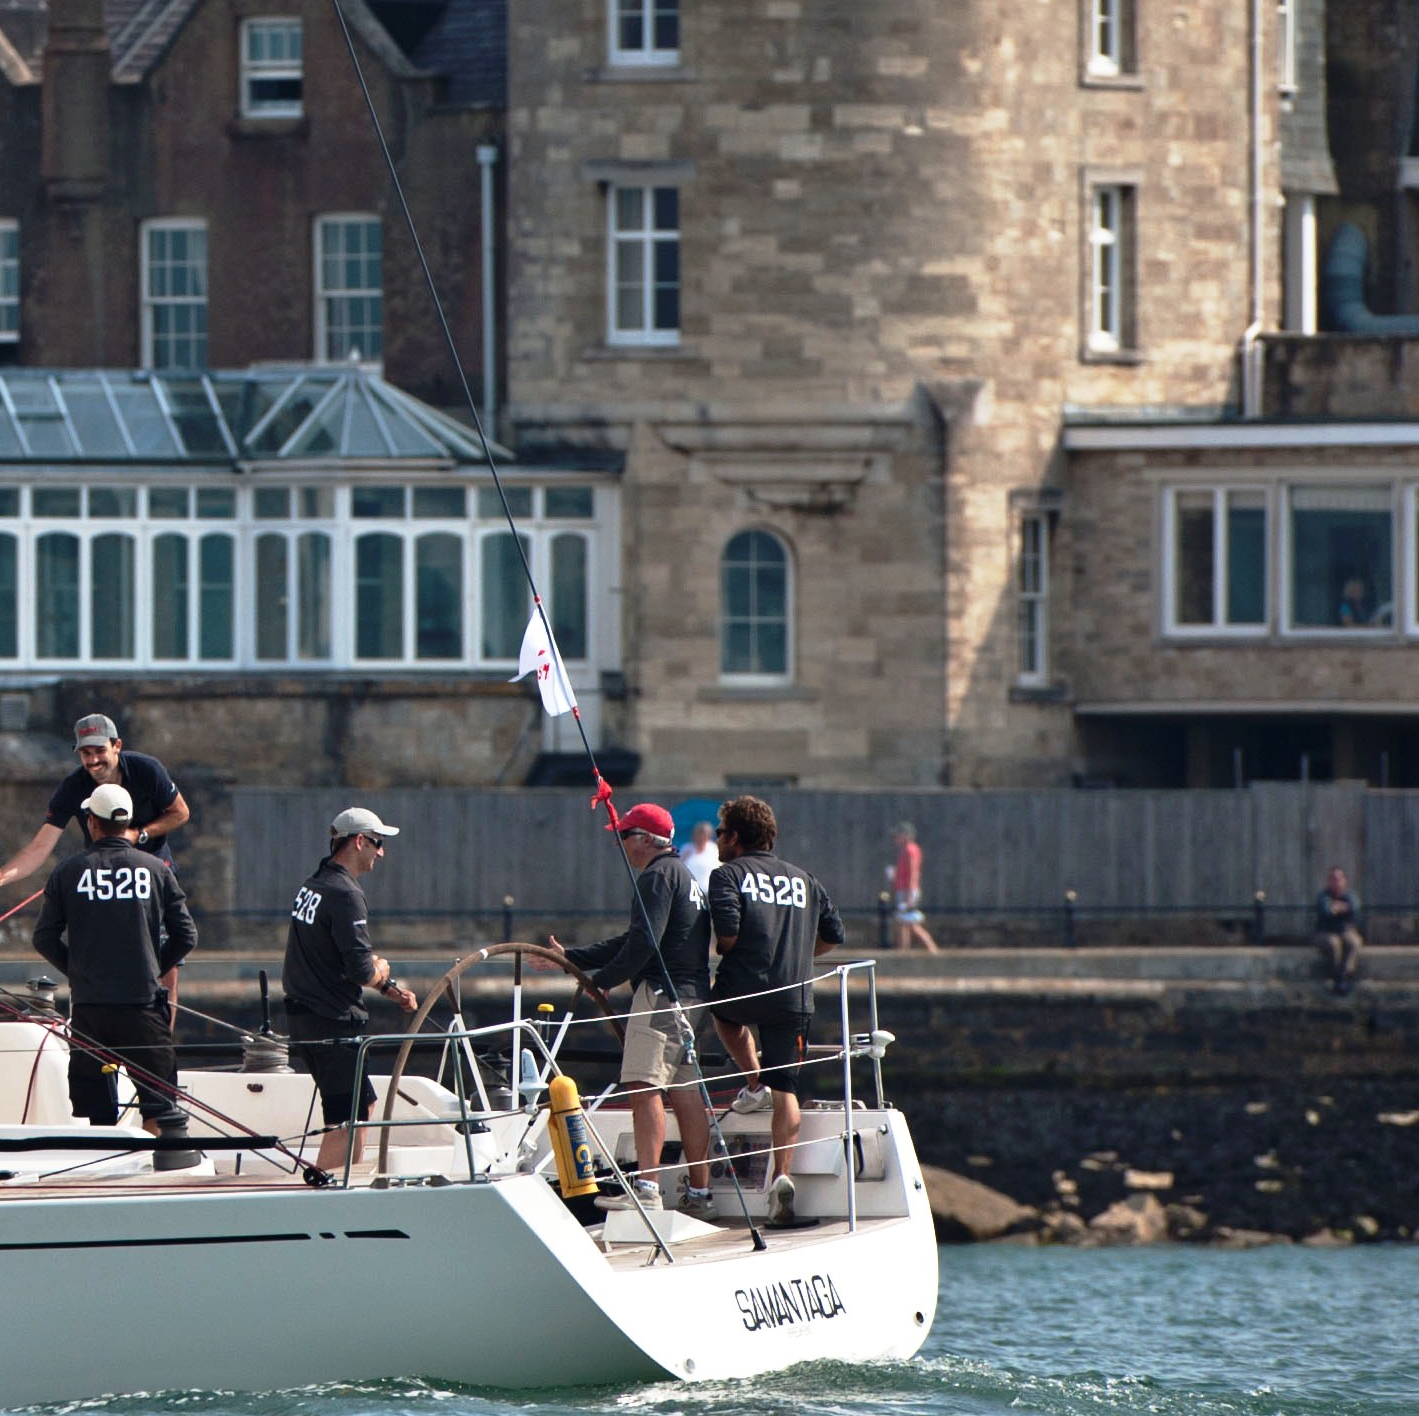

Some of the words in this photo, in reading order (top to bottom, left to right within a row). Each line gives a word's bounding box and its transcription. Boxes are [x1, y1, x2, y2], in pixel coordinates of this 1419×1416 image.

[76, 867, 151, 901] 4528
[741, 872, 807, 909] 4528
[735, 1273, 847, 1332] SAMANTAGA
